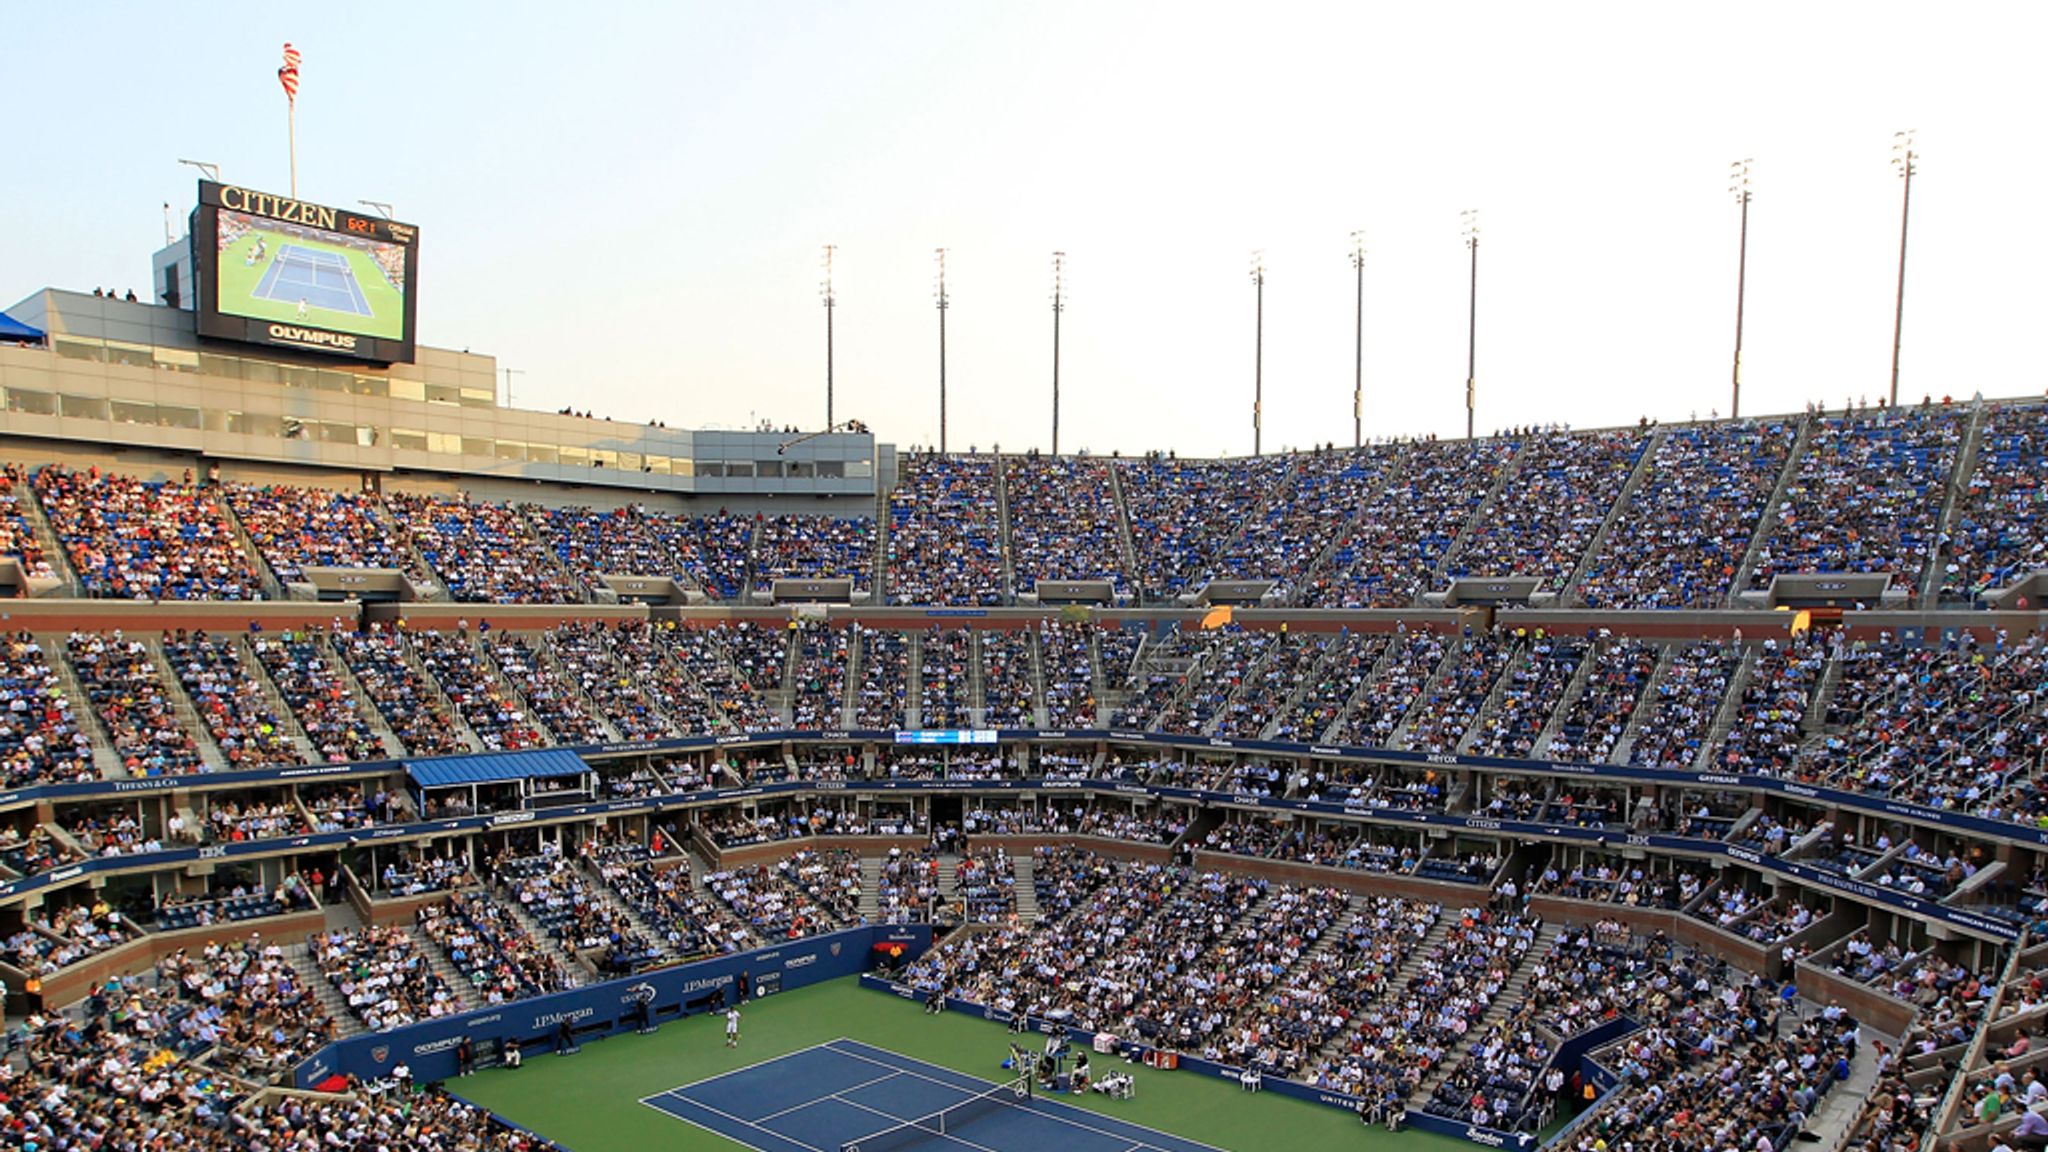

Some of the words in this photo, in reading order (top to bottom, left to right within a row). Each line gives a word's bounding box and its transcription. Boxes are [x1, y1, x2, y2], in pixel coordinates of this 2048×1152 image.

[220, 185, 337, 230] CITIZEN
[269, 325, 357, 348] OLYMPUS
[1626, 834, 1649, 845] IBM
[199, 845, 226, 858] IBM
[1948, 912, 1984, 928] AMERICAN
[1985, 922, 2018, 938] EXPRESS
[414, 1036, 463, 1053] OLYMPUS
[1320, 1094, 1355, 1108] UNITED
